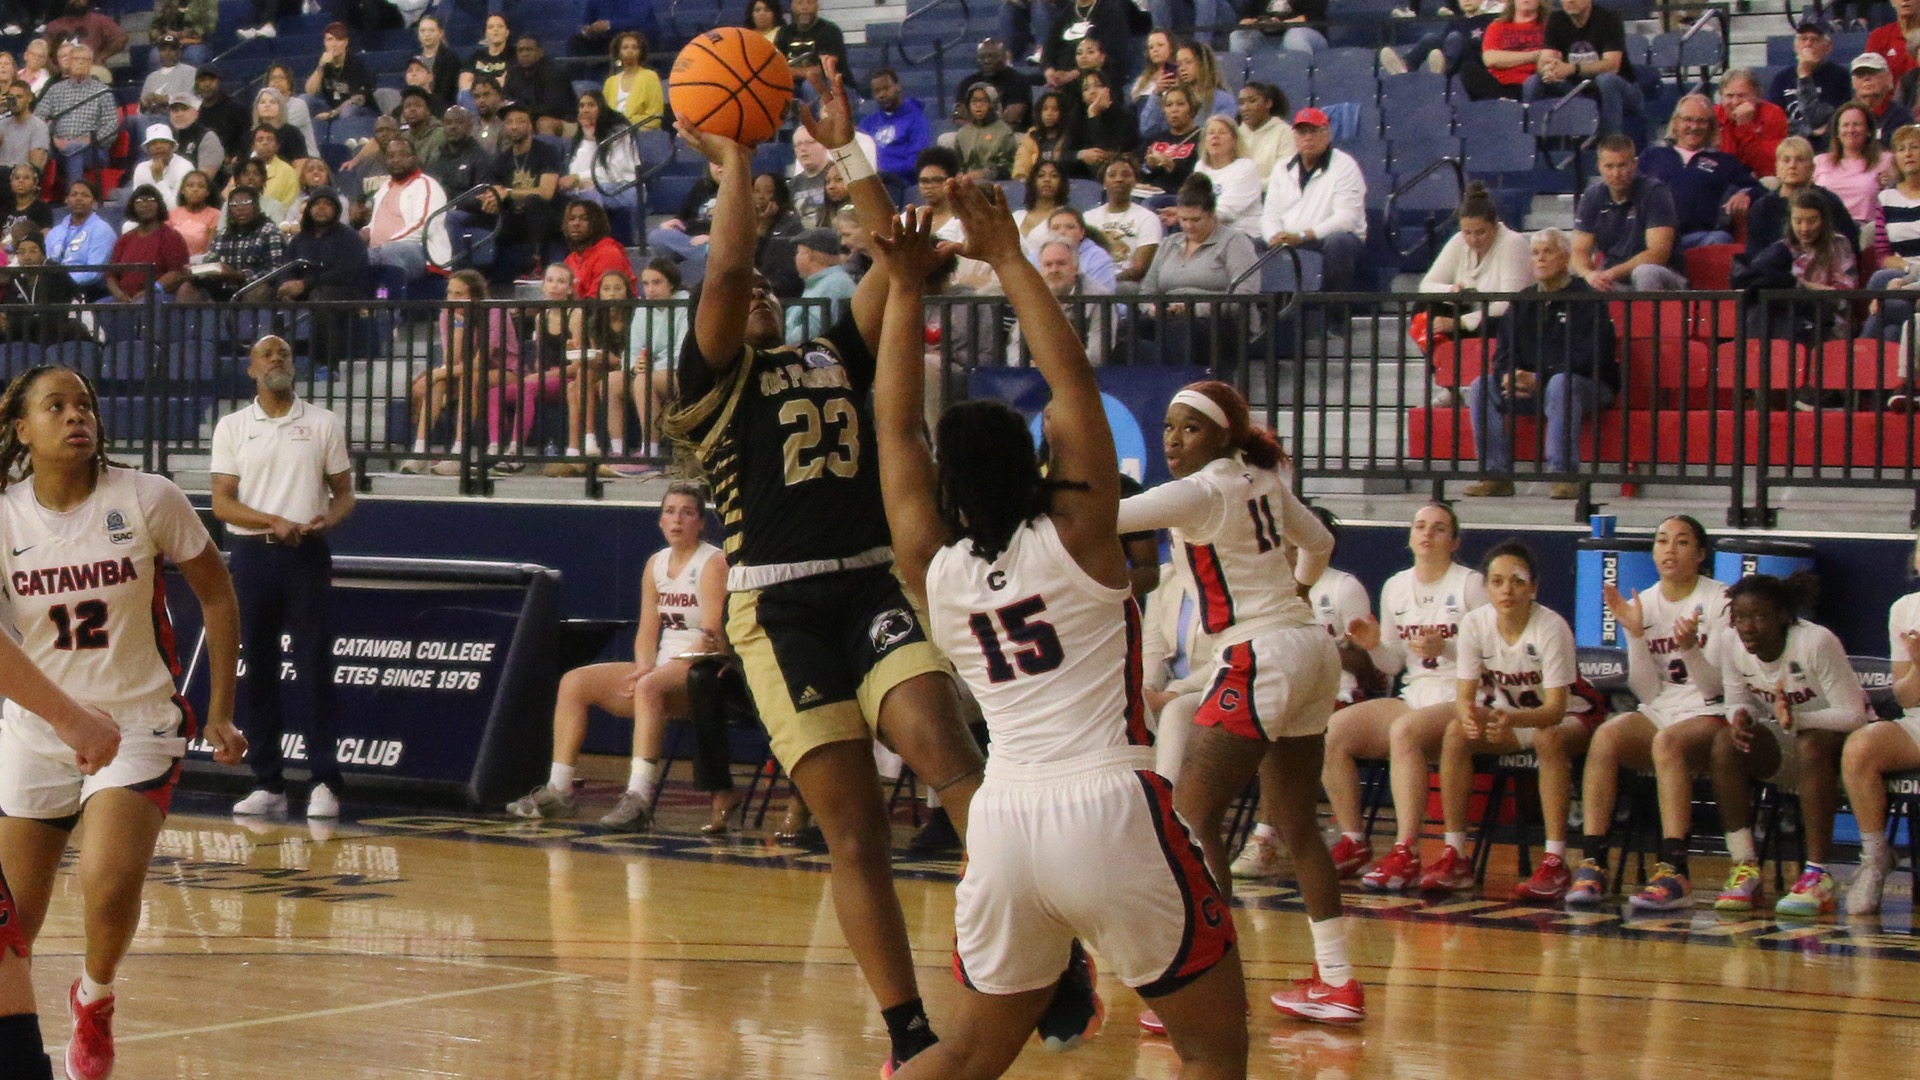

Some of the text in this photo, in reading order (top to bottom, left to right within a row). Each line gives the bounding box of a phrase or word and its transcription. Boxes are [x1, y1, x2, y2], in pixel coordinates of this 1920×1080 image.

[778, 398, 860, 486] 23
[112, 531, 133, 542] SAC
[1247, 494, 1281, 554] 11
[11, 556, 138, 596] CATAWBA
[986, 570, 1007, 592] C
[48, 598, 109, 651] 12
[968, 593, 1065, 684] 15
[332, 637, 496, 662] CATAWBA COLLEGE
[380, 668, 435, 688] SINCE
[436, 670, 481, 690] 1976
[1219, 688, 1240, 711] C
[336, 737, 403, 766] CLUB
[1201, 895, 1222, 929] C
